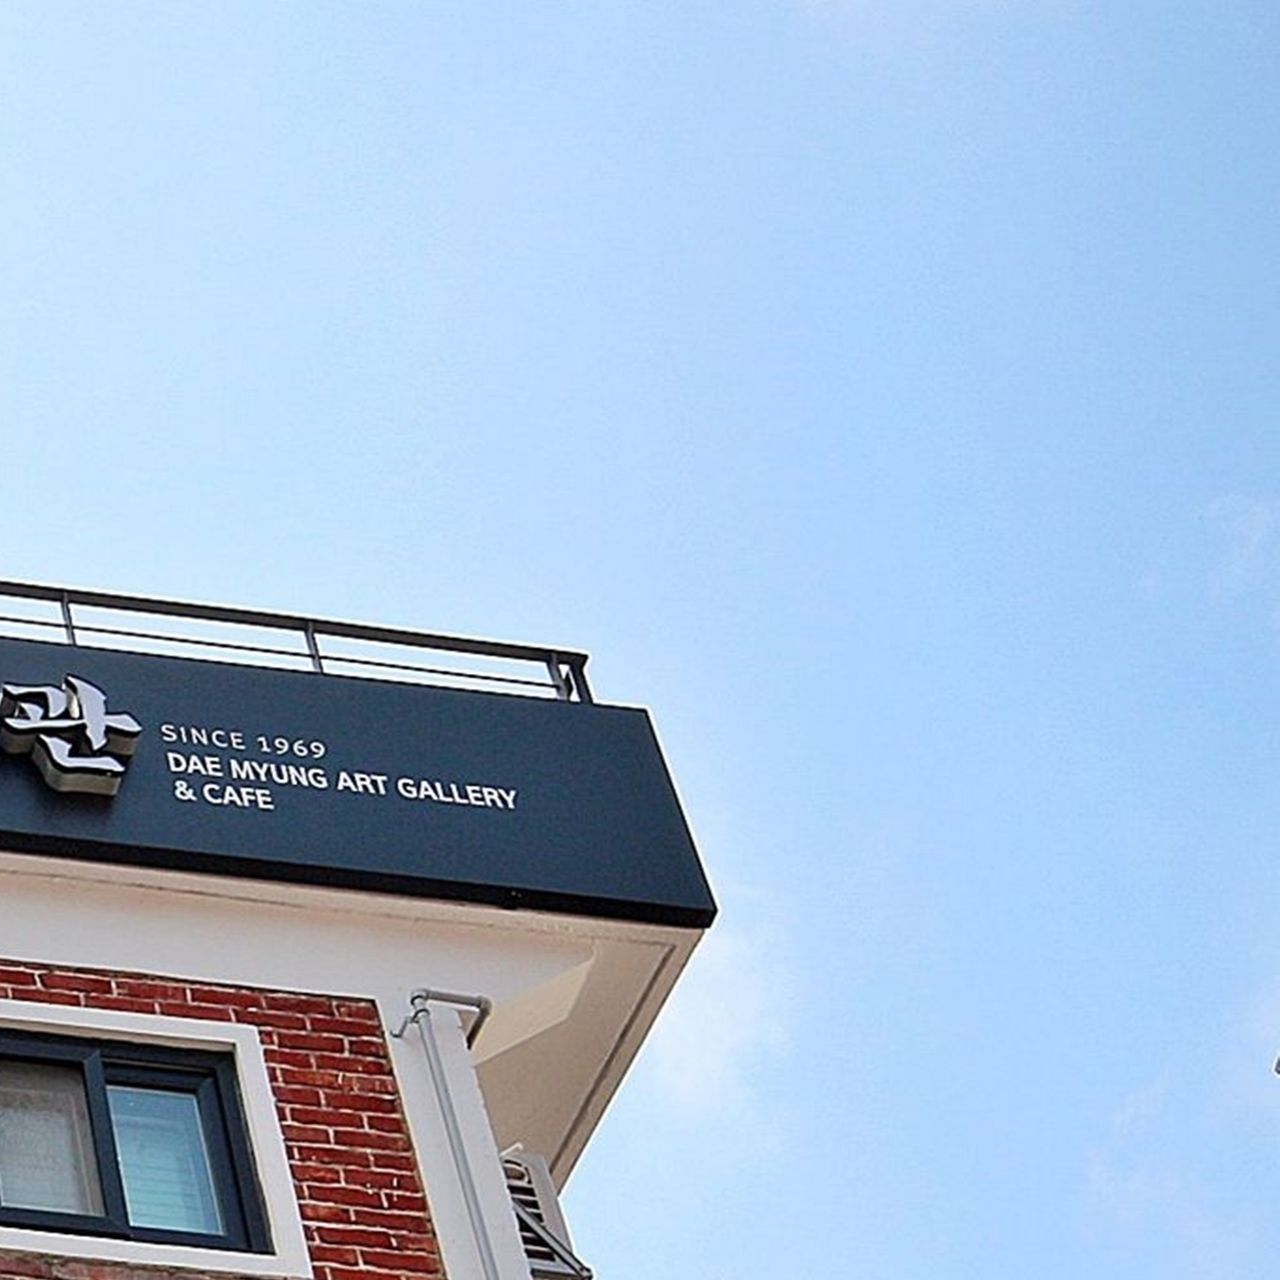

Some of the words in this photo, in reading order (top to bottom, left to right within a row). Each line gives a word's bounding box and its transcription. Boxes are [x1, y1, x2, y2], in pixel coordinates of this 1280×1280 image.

[160, 723, 246, 750] SINCE
[256, 735, 327, 759] 1969
[166, 751, 224, 777] DAE
[230, 757, 329, 790] MYUNG
[336, 771, 388, 796] ART
[396, 777, 517, 809] GALLERY
[174, 779, 197, 801] &
[202, 783, 275, 811] CAFE
